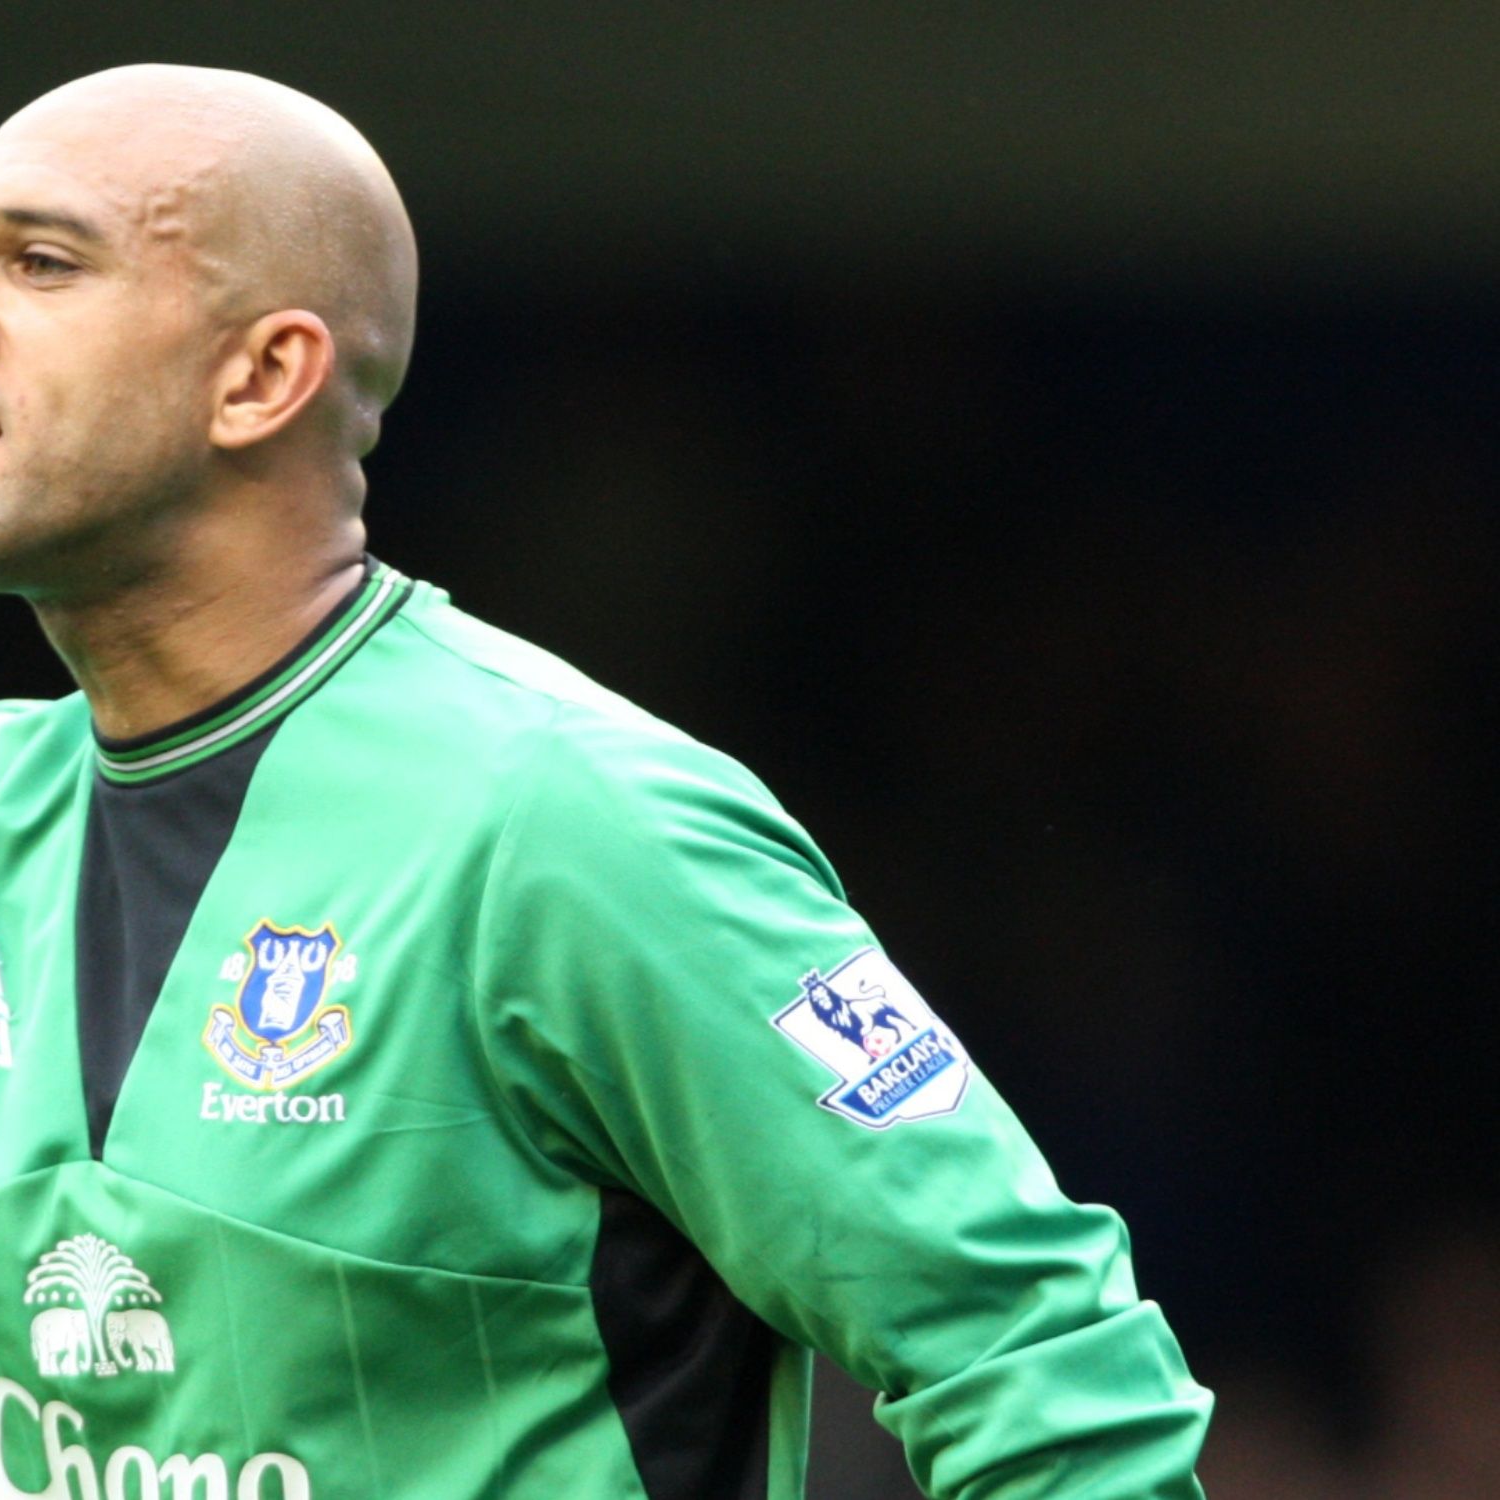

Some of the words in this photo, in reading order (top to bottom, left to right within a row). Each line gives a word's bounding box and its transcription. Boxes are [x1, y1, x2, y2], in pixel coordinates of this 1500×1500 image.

[855, 1034, 941, 1106] BARCLAYS
[201, 1082, 345, 1123] Everton
[870, 1075, 918, 1115] PREMIER
